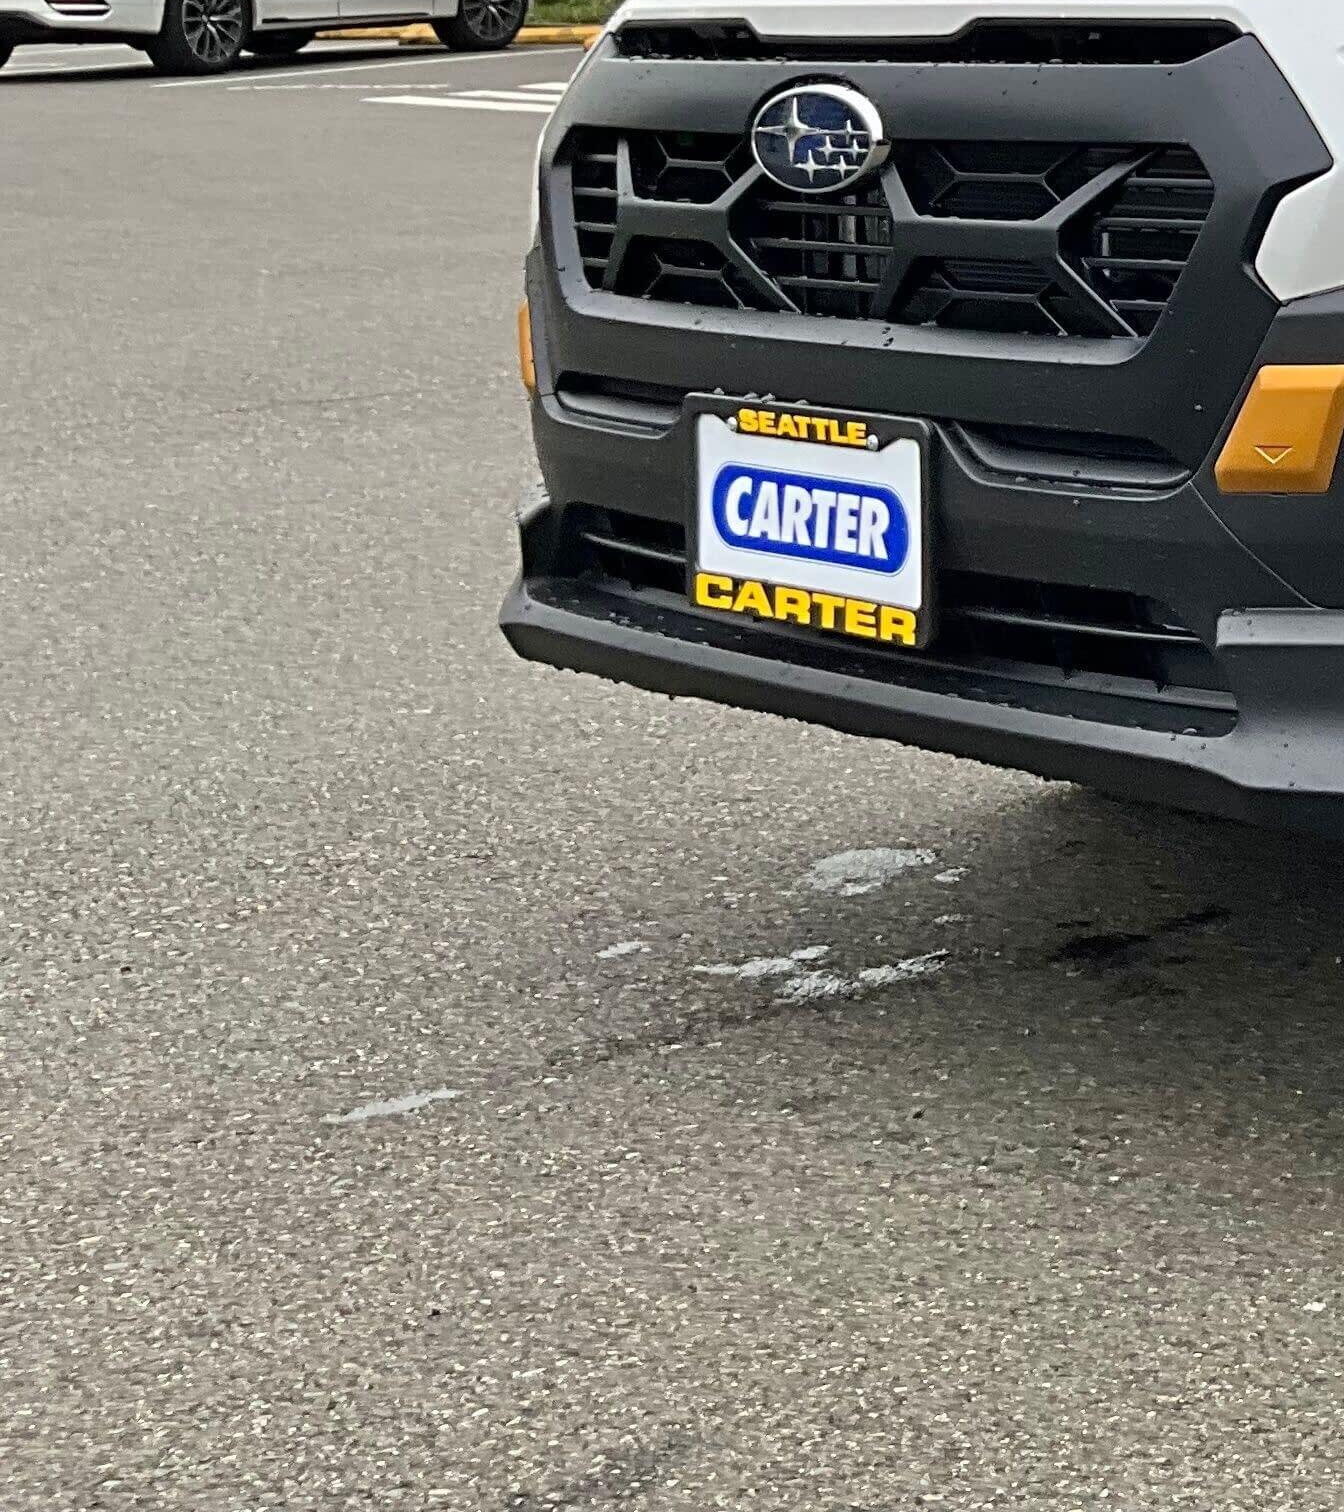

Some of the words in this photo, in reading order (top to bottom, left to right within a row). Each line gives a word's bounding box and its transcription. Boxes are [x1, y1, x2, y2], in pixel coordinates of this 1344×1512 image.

[738, 408, 868, 446] SEATTLE
[725, 475, 891, 561] CARTER
[695, 572, 917, 647] CARTER
